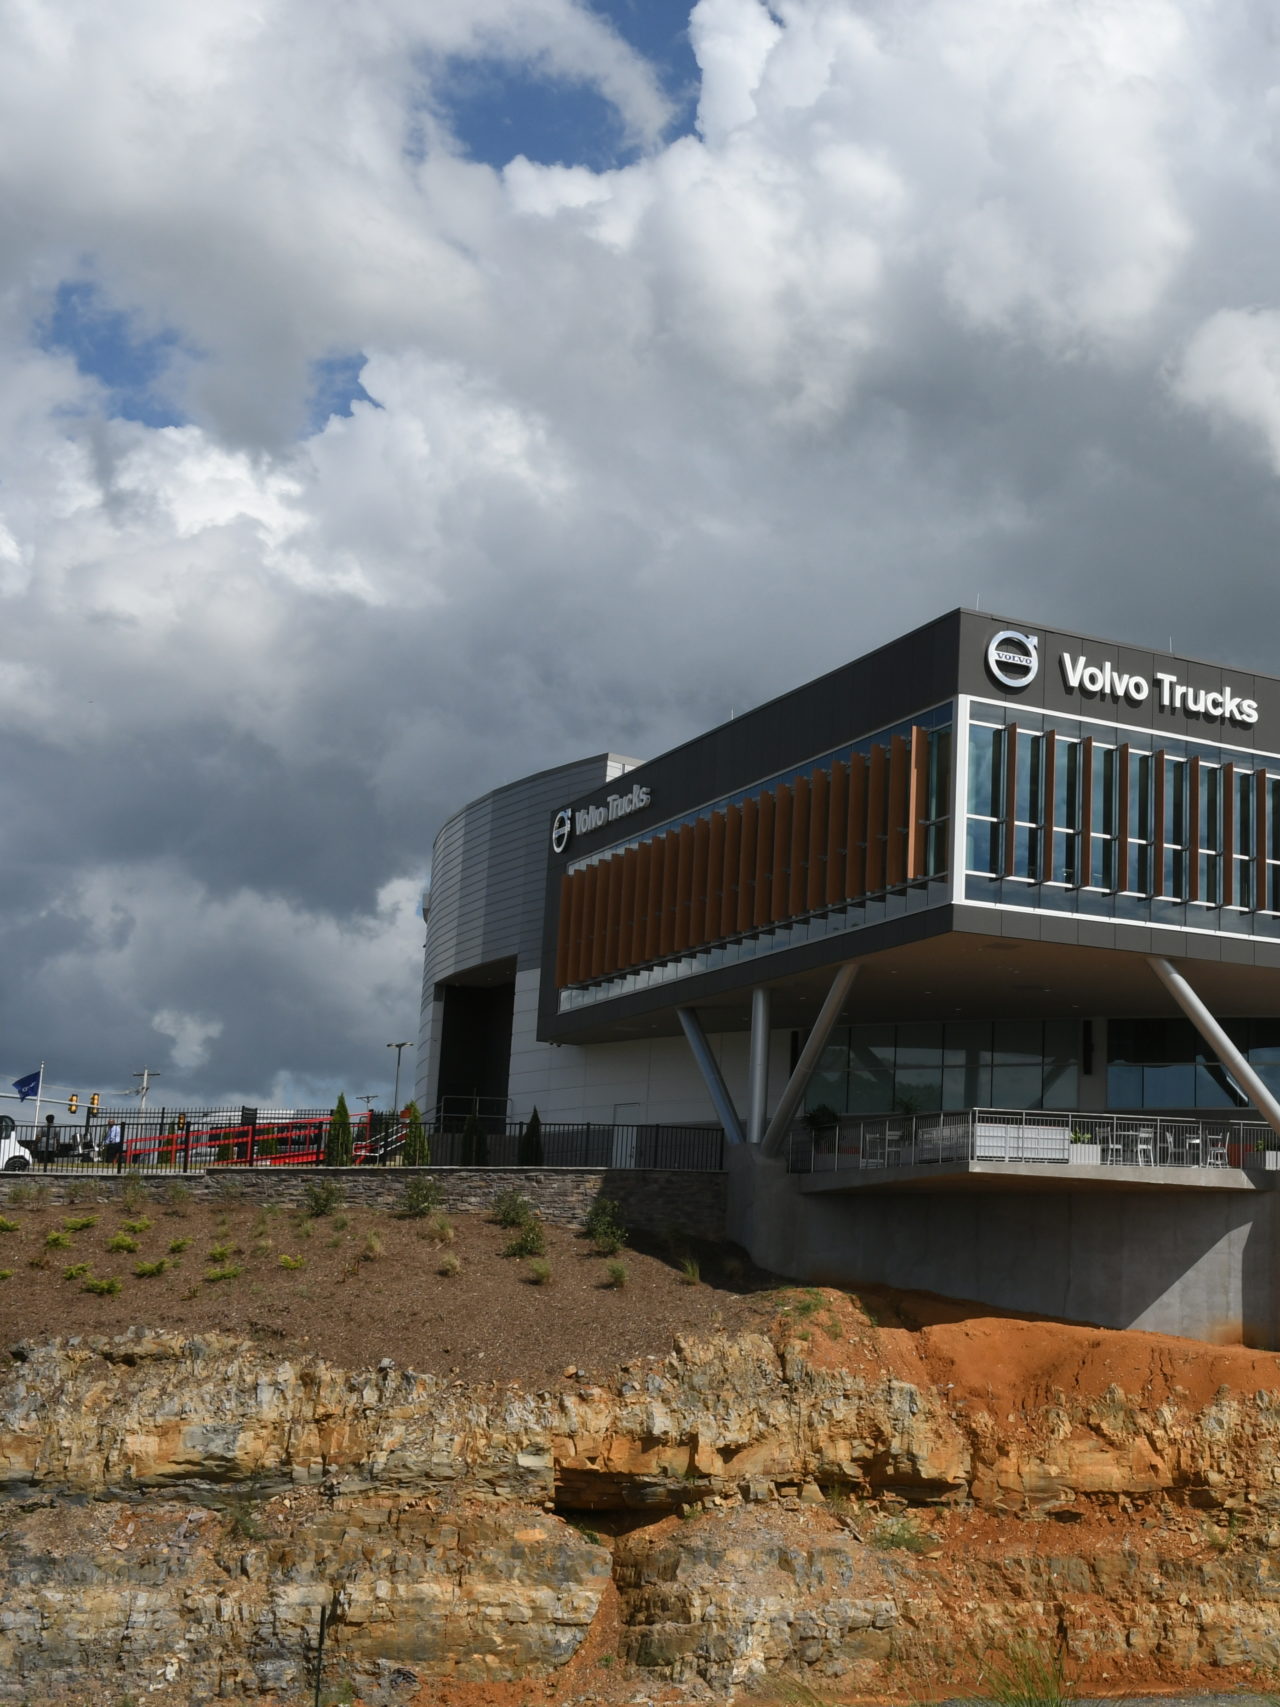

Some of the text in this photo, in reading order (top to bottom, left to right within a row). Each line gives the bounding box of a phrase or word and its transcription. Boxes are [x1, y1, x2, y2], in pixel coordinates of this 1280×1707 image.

[996, 652, 1033, 665] VOLVO
[1061, 652, 1259, 724] Volvo Trucks
[575, 784, 651, 835] Volvo Trucks
